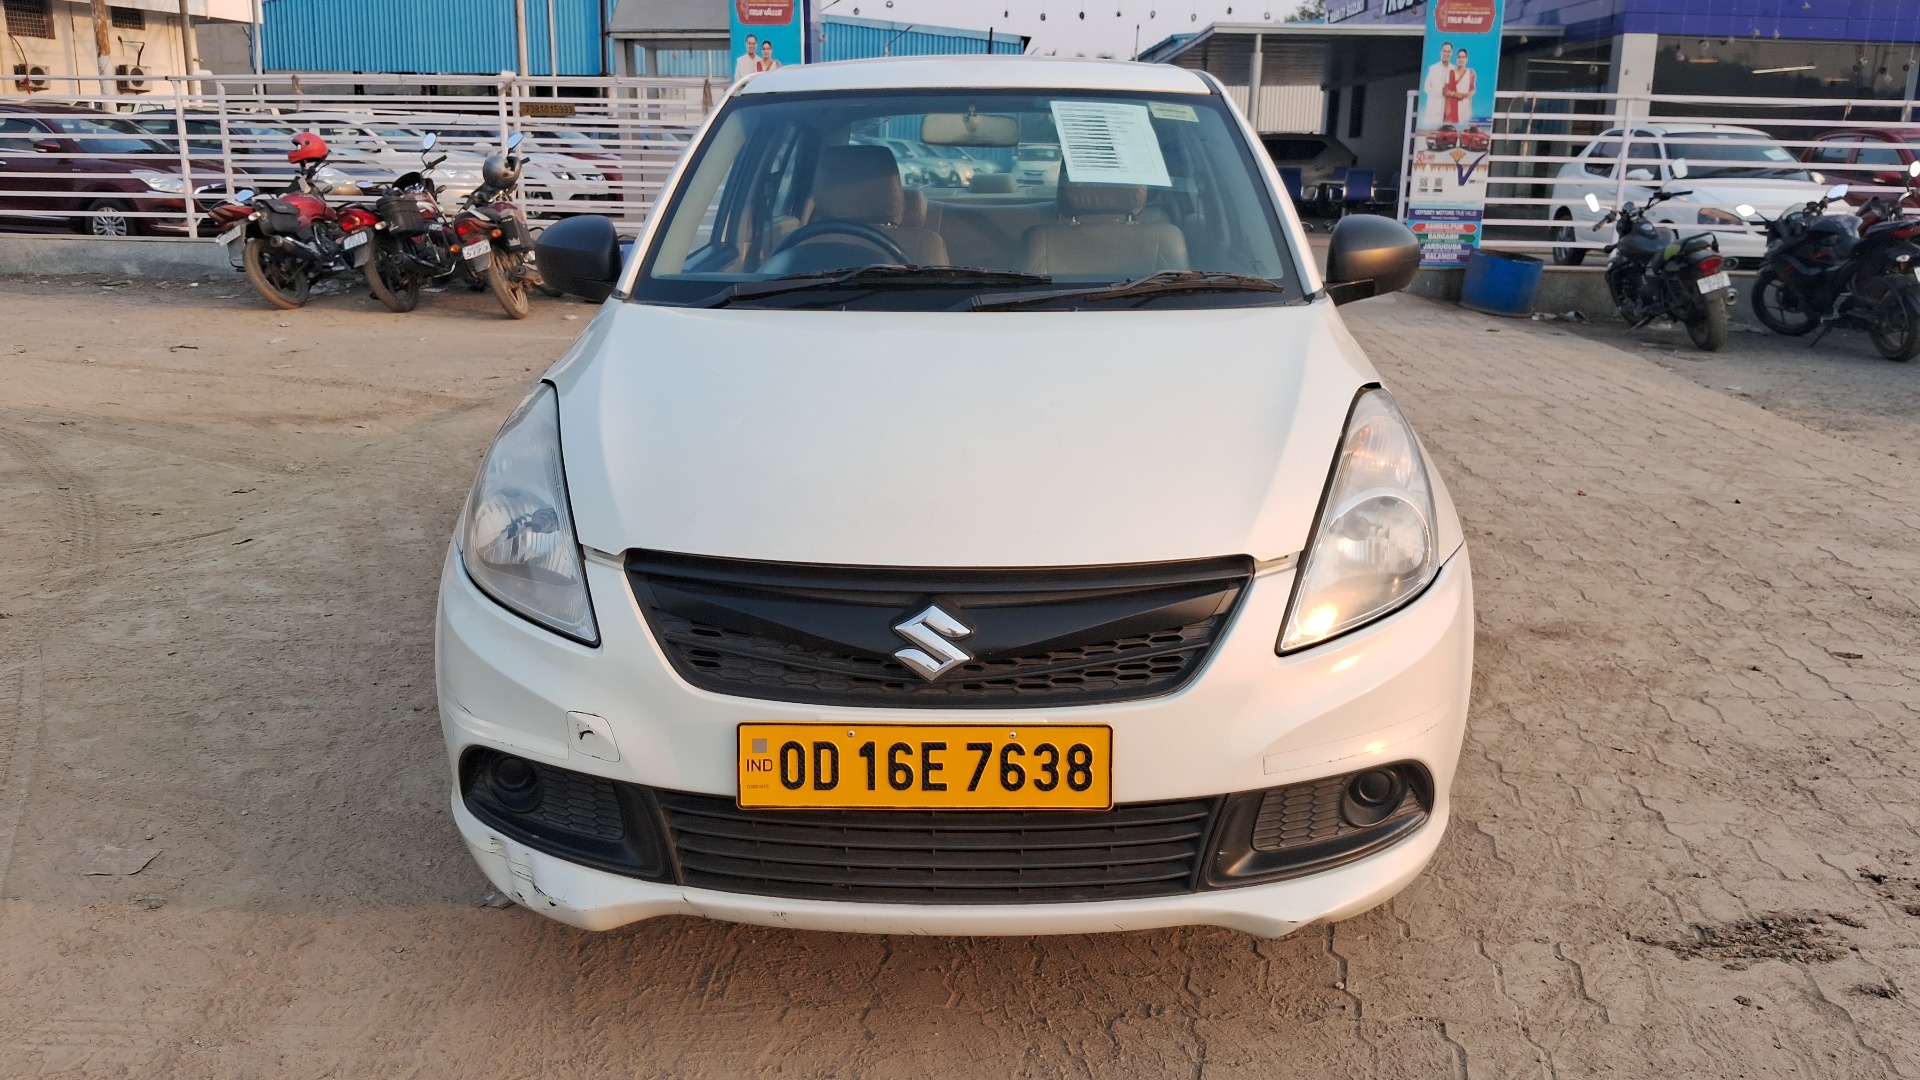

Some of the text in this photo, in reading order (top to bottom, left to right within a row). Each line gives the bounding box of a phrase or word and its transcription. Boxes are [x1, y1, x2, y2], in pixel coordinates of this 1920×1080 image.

[746, 758, 773, 772] IND
[779, 740, 1094, 792] OD 16E 7638
